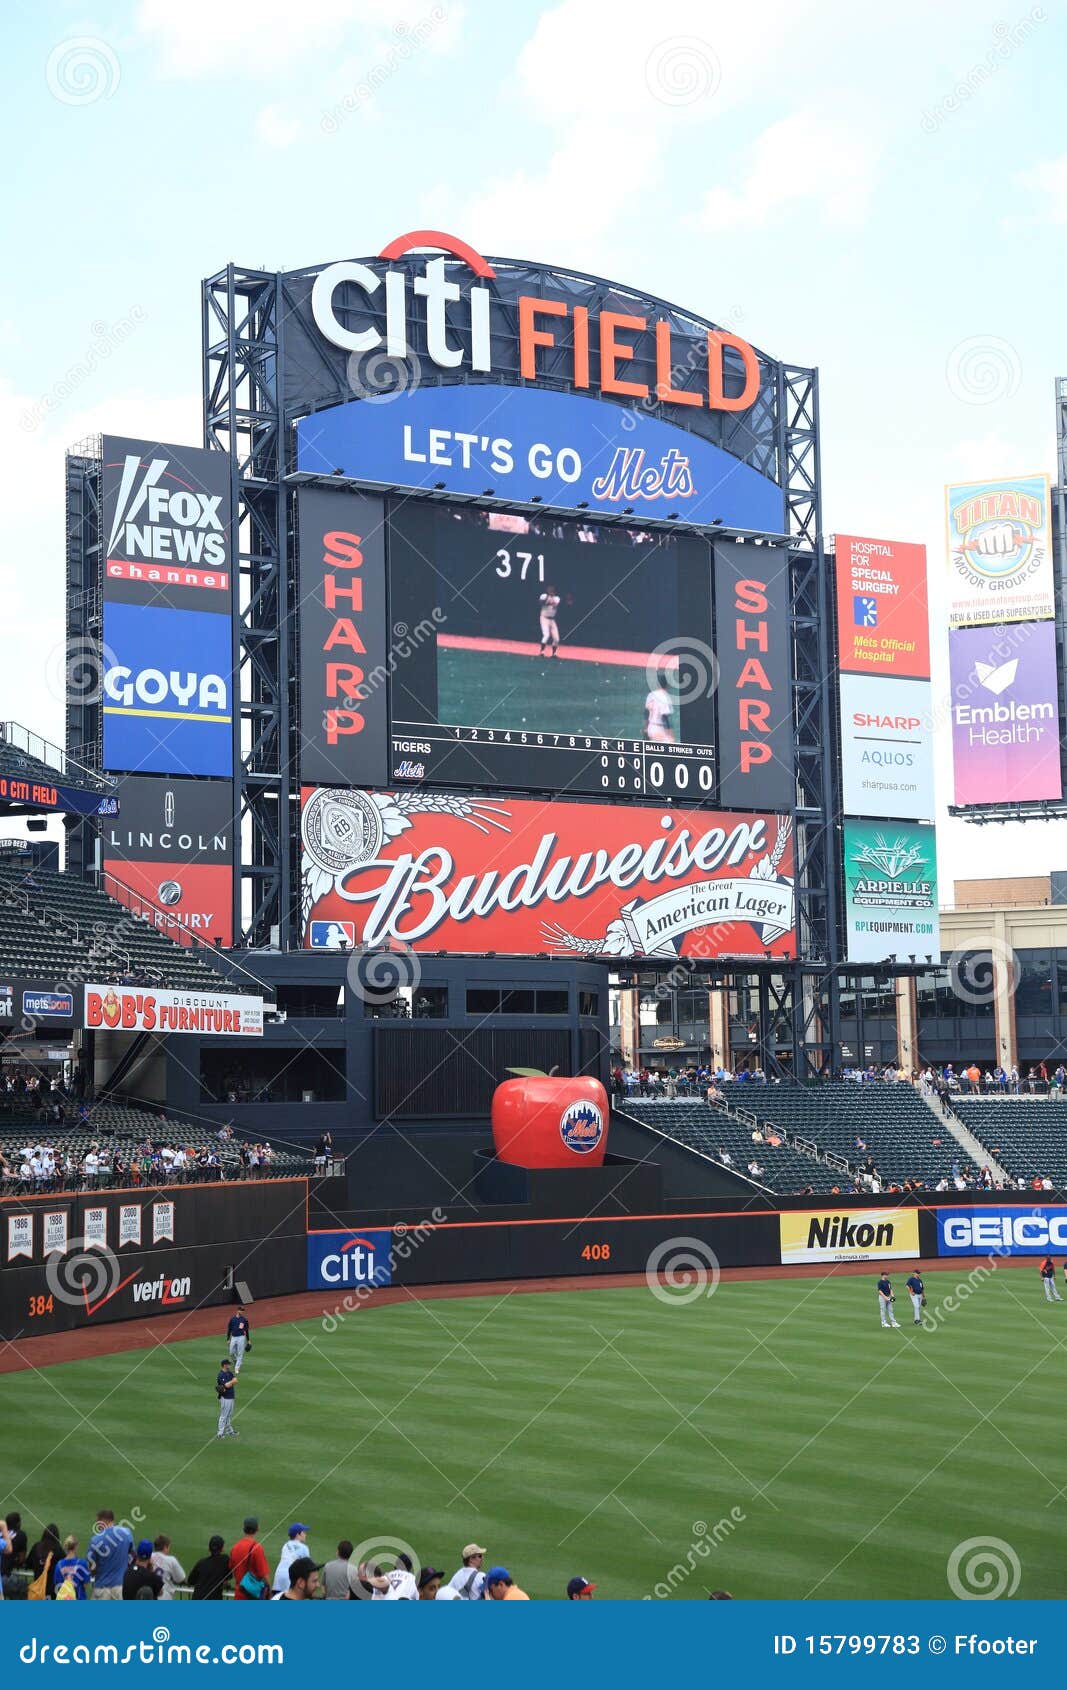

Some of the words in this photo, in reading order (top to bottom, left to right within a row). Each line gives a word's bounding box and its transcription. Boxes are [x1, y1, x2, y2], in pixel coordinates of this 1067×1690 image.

[311, 254, 491, 372] citi
[518, 295, 761, 412] FIELD
[402, 425, 513, 474] LET'S
[528, 443, 583, 483] GO
[591, 446, 694, 501] Mets
[148, 487, 225, 531] FOX
[955, 493, 1042, 531] TITAN
[125, 523, 226, 566] NEWS
[850, 542, 895, 557] HOSPITAL
[495, 549, 545, 582] 371
[850, 555, 870, 566] FOR
[109, 564, 226, 588] channel
[851, 567, 894, 581] SPECIAL
[953, 555, 986, 590] MOTOR
[851, 580, 900, 594] SURGERY
[950, 612, 965, 622] NEW
[966, 611, 972, 621] &
[973, 610, 991, 621] USED
[991, 608, 1005, 619] CAR
[1006, 605, 1052, 618] SUPERSTORES
[322, 530, 367, 745] SHARP
[853, 635, 878, 648] Mets
[880, 638, 916, 652] Official
[853, 648, 895, 663] Hospital
[735, 579, 773, 773] SHARP
[103, 665, 227, 710] GOYA
[853, 713, 921, 730] SHARP
[955, 700, 1054, 725] Emblem
[455, 728, 461, 738] 1
[471, 729, 478, 740] 2
[488, 730, 494, 740] 3
[504, 732, 511, 742] 4
[521, 733, 527, 743] 5
[537, 734, 543, 744] 6
[553, 736, 560, 745] 7
[569, 737, 576, 746] 8
[585, 738, 591, 748] 9
[601, 740, 608, 749] R
[617, 741, 624, 751] H
[633, 743, 640, 752] E
[969, 722, 1041, 746] Health
[392, 741, 432, 754] TIGERS
[645, 744, 665, 752] BALLS
[668, 746, 693, 754] STRIKES
[696, 748, 713, 756] OUTS
[394, 760, 425, 778] Mets
[601, 756, 609, 767] 0
[618, 757, 625, 769] 0
[633, 758, 641, 769] 0
[861, 750, 914, 767] AQUOS
[602, 775, 609, 787] 0
[618, 776, 626, 788] 0
[634, 777, 641, 789] 0
[650, 762, 664, 787] 0
[674, 763, 689, 789] 0
[699, 765, 713, 791] 0
[861, 779, 917, 793] sharpusa.com
[10, 781, 29, 800] CITI
[32, 785, 58, 806] FIELD
[111, 830, 227, 851] LINCOLN
[334, 814, 767, 949] Budweiser
[690, 884, 707, 895] The
[708, 881, 734, 893] Great
[855, 880, 931, 894] ARPIELLE
[854, 897, 914, 906] EQUIPMENT
[915, 899, 934, 907] CO.
[141, 911, 213, 929] ERCURY
[645, 893, 729, 940] American
[735, 891, 787, 917] Lager
[855, 921, 933, 934] RPLEQUIPMENT.COM
[25, 998, 70, 1010] mets.com
[87, 992, 157, 1031] BOB'S
[173, 997, 229, 1008] DISCOUNT
[159, 1005, 241, 1032] FURNITURE
[568, 1119, 598, 1138] Mets
[807, 1216, 894, 1249] Nikon
[581, 1244, 610, 1260] 408
[320, 1246, 374, 1283] citi
[133, 1273, 190, 1305] verizon
[28, 1295, 54, 1316] 384
